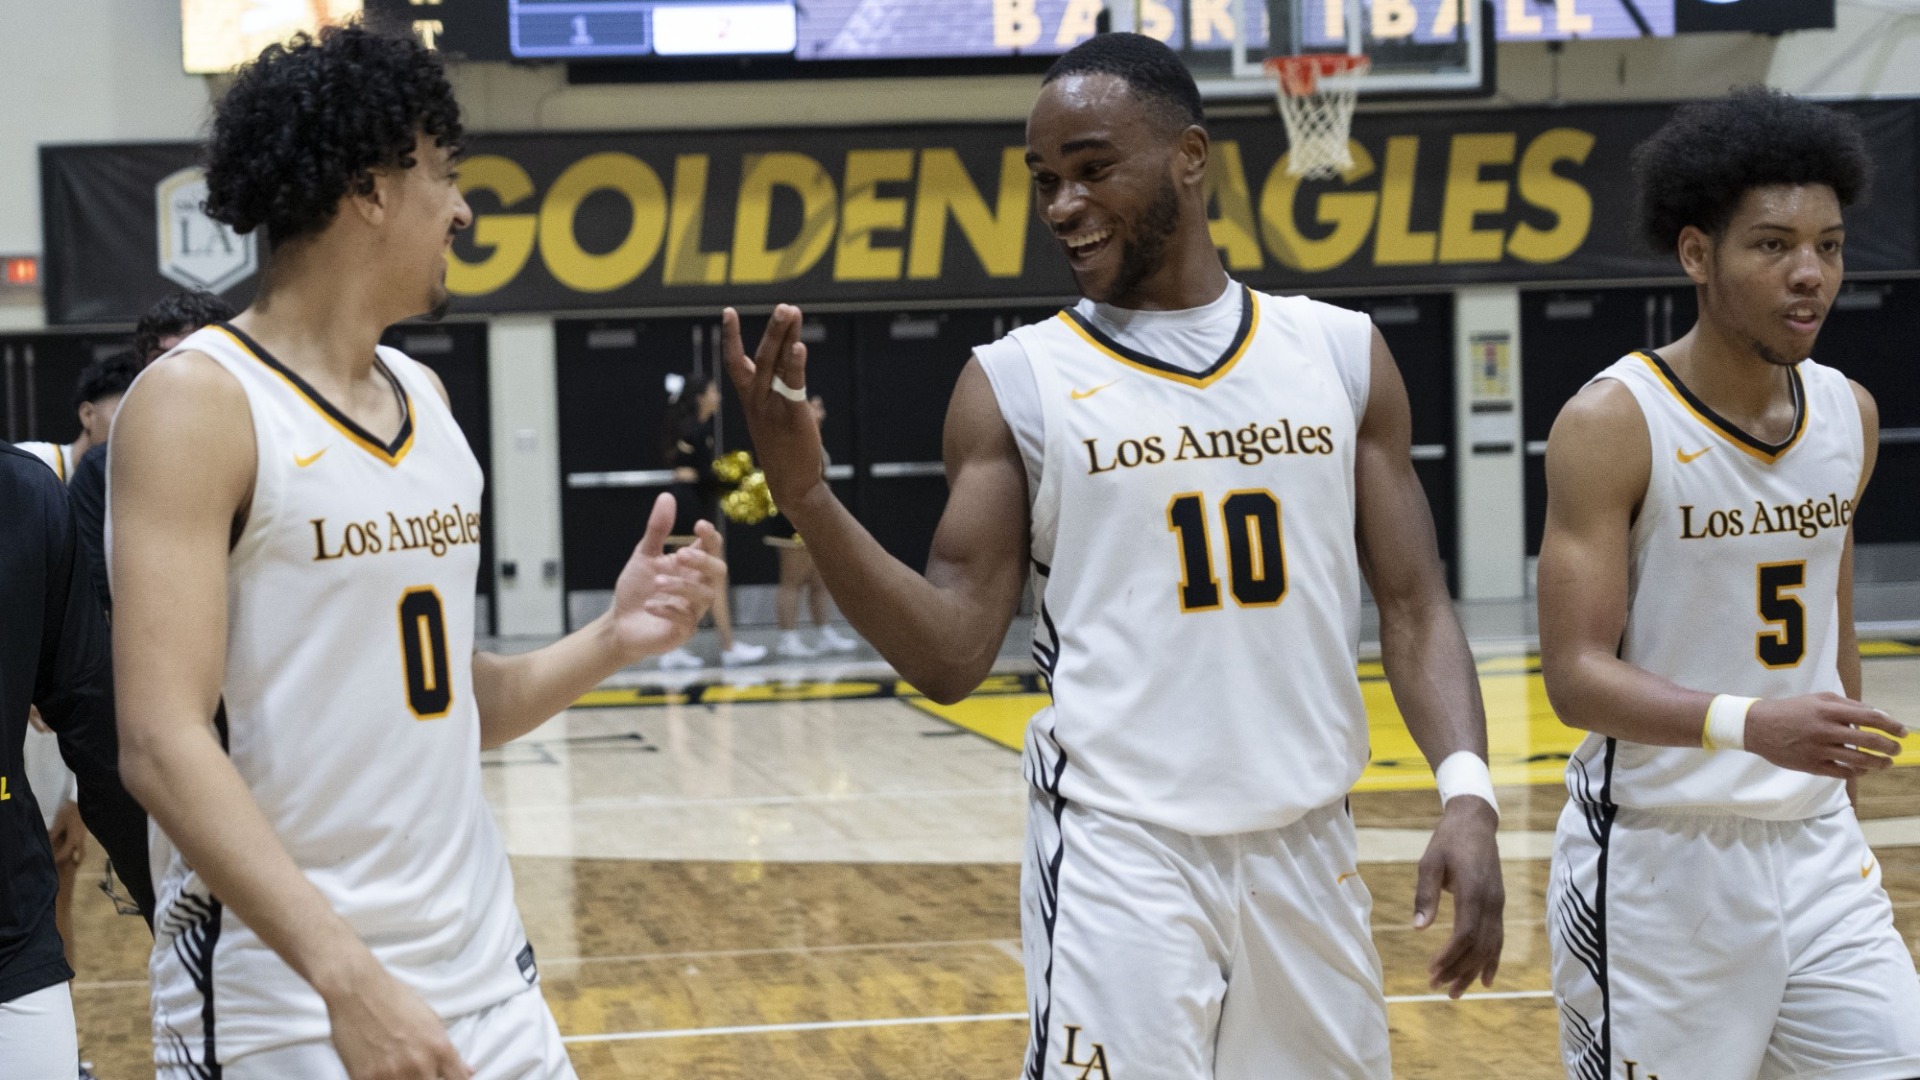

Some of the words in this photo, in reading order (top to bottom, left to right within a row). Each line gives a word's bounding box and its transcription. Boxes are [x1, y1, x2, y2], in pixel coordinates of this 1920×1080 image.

[569, 14, 594, 45] 1
[445, 147, 1032, 295] GOLDEN
[1206, 127, 1597, 272] AGLES
[1083, 435, 1165, 475] Los
[1173, 418, 1334, 466] Angeles
[309, 517, 384, 562] Los
[1165, 488, 1289, 614] 10
[1679, 504, 1744, 540] Los
[1749, 493, 1852, 540] Angele
[397, 584, 454, 722] 0
[1755, 559, 1807, 671] 5
[1060, 1024, 1111, 1080] LA
